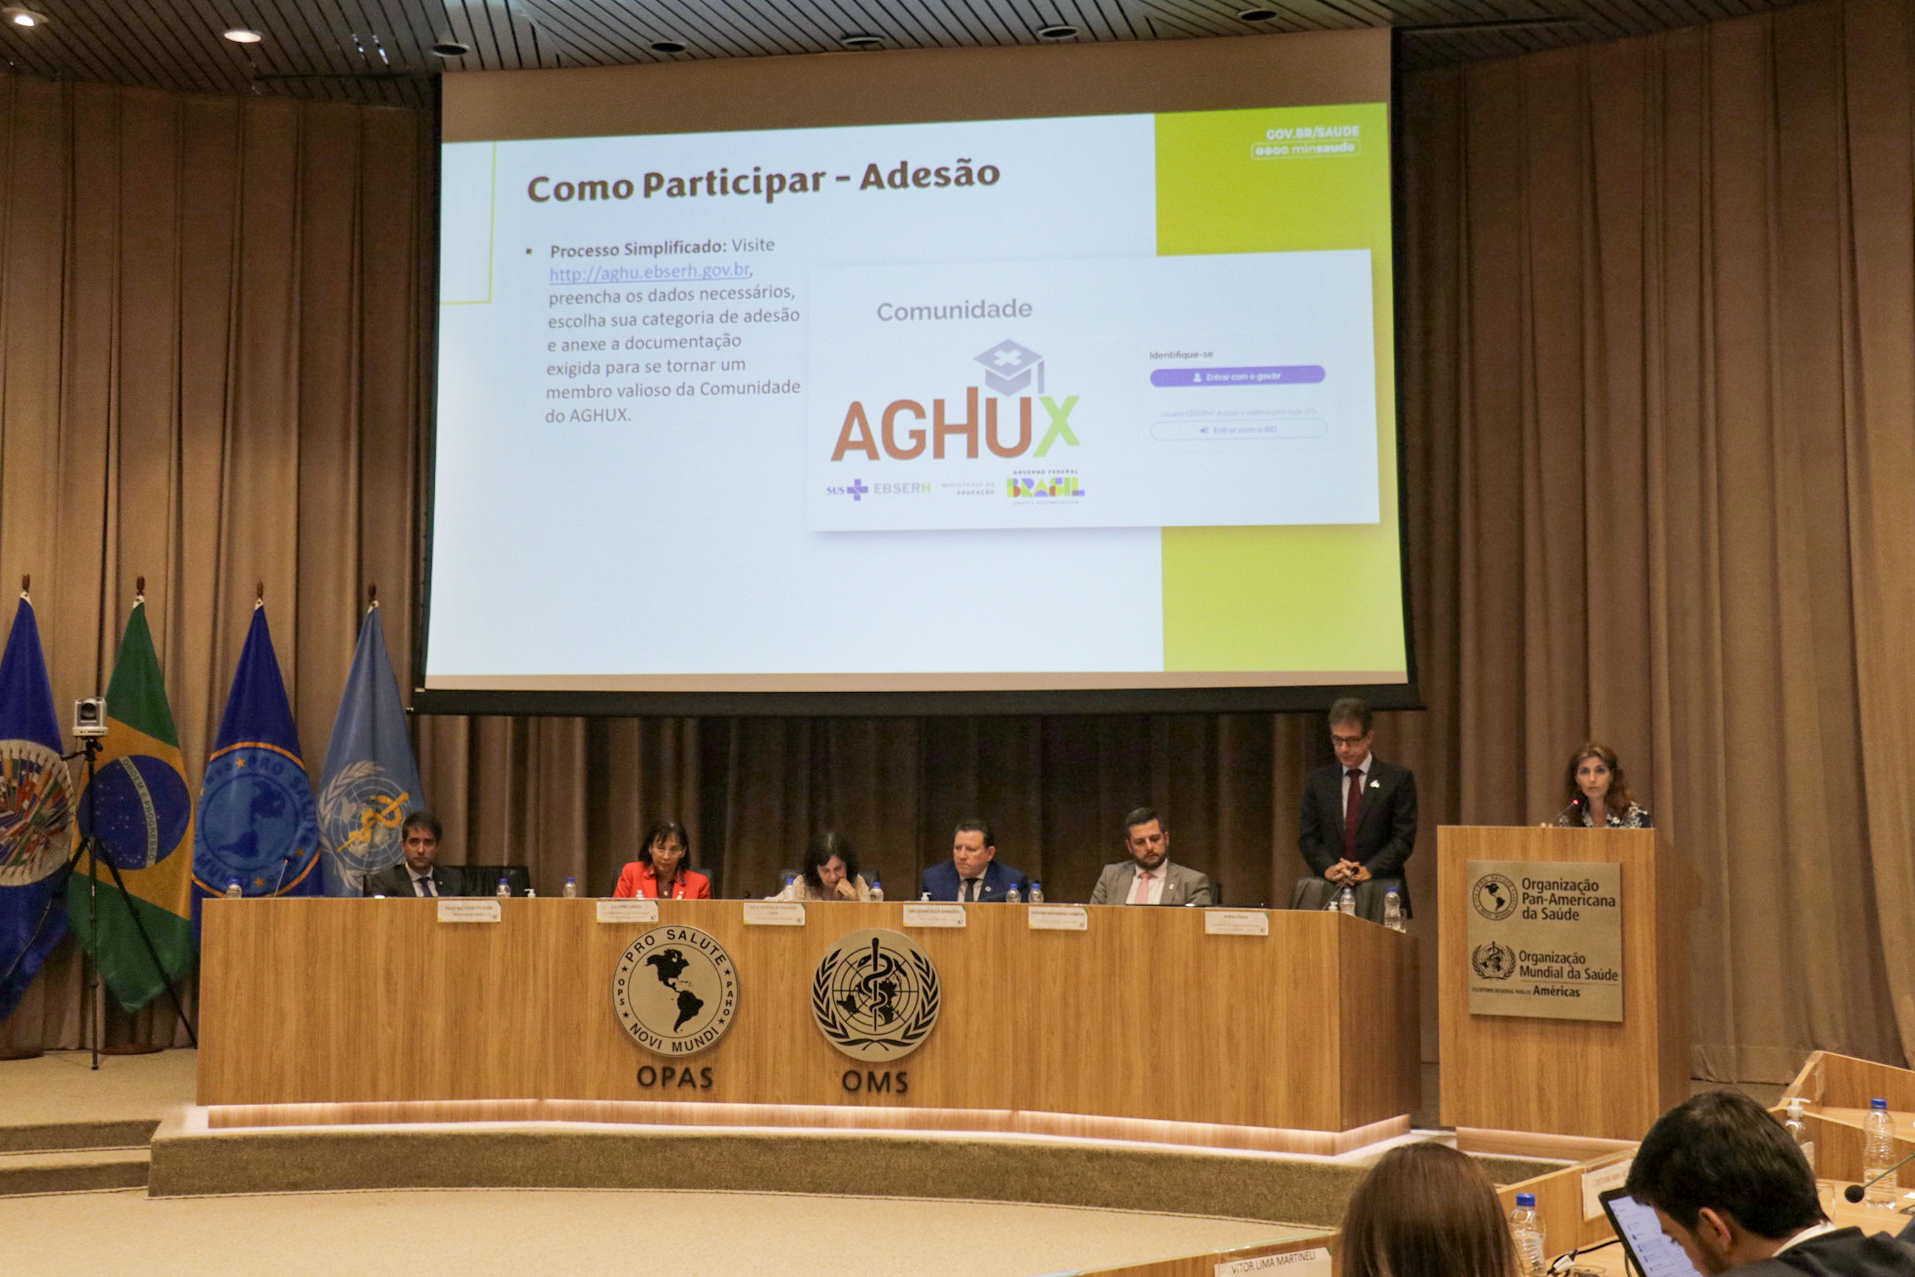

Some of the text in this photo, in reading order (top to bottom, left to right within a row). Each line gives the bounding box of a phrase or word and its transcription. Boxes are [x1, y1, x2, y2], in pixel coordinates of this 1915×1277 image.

[1266, 125, 1360, 140] GOV.BR/SAUDE
[1292, 142, 1355, 154] minsaude
[527, 174, 635, 203] Como
[643, 166, 827, 204] Participar
[859, 157, 1001, 190] Adesão
[551, 238, 775, 258] Processo Simplificado: Visite
[549, 262, 753, 285] http://aghu.ebserh.gov.br,
[549, 283, 795, 309] preencha os dados necessários,
[548, 307, 800, 328] escolha sua categoria de adesão
[877, 298, 1033, 322] Comunidade
[547, 332, 741, 352] e anexe a documentação
[1149, 351, 1213, 360] Identifique-se
[547, 359, 746, 379] exigida para se tornar um
[1206, 374, 1230, 382] Entrar
[546, 379, 801, 399] membro valioso da Comunidade
[545, 407, 631, 423] do AGHUX.
[831, 386, 1081, 461] AGHUX
[827, 486, 845, 495] SUS
[874, 482, 931, 494] EBSERH
[1006, 477, 1085, 497] BRASIL
[1522, 877, 1600, 894] Organização
[1522, 892, 1616, 908] Pan-Americana
[1522, 907, 1580, 921] da Saúde
[625, 929, 727, 966] PRO SALUTE
[1518, 950, 1586, 965] Organização
[1519, 965, 1619, 982] Mundial da Saúde
[617, 978, 626, 1006] OPS
[722, 981, 734, 1017] PAHO
[1532, 984, 1581, 998] Américas
[629, 1022, 719, 1053] NOVI MUNDI
[636, 1065, 714, 1090] OPAS
[842, 1069, 909, 1094] OMS
[1256, 1258, 1276, 1270] LIMA
